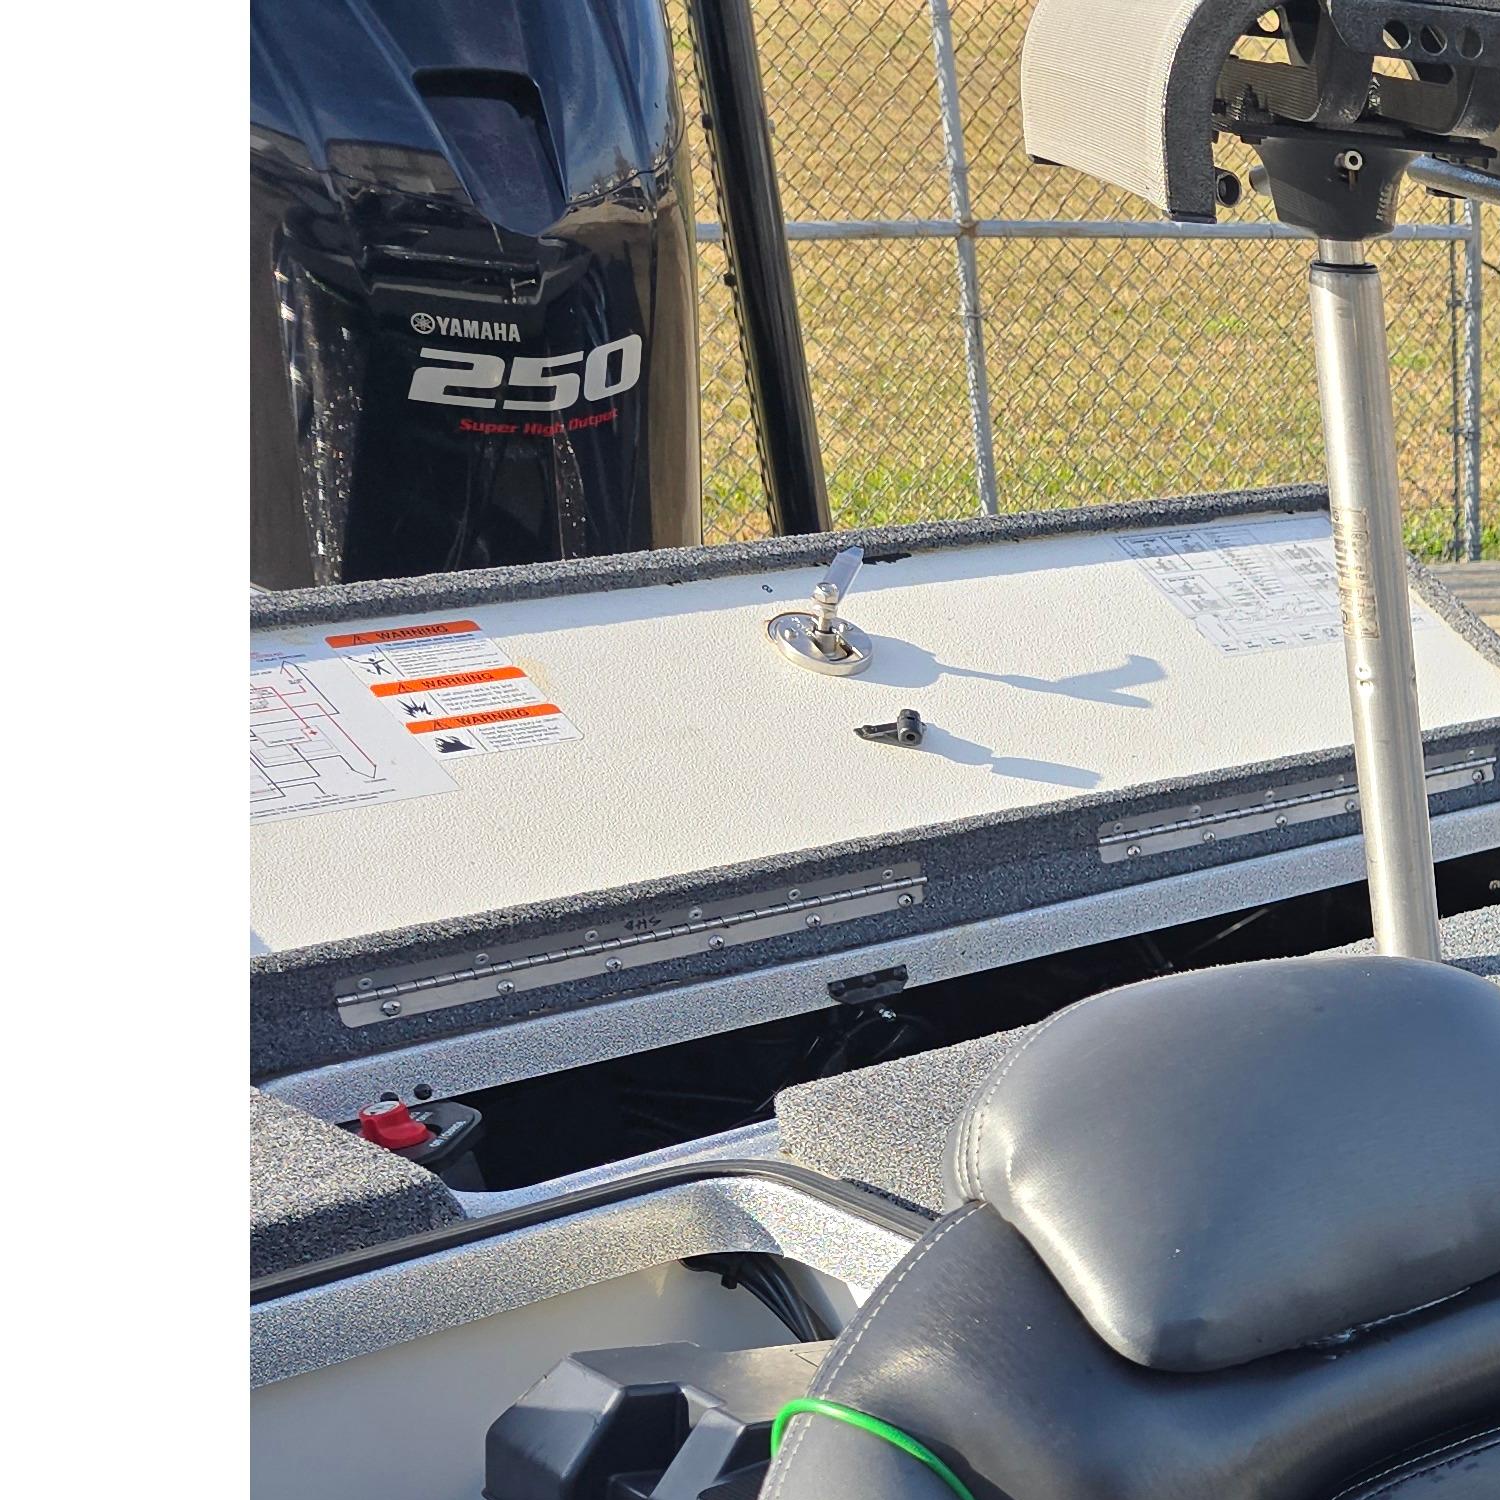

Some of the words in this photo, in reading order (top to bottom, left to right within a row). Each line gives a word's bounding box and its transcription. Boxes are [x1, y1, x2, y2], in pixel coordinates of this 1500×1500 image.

[435, 315, 521, 343] YAMAHA
[408, 334, 643, 412] 250
[459, 418, 518, 434] Super
[522, 421, 565, 437] High
[567, 408, 619, 431] Output
[375, 624, 449, 642] WARNING
[420, 671, 496, 690] WARNING
[455, 708, 530, 727] WARNING
